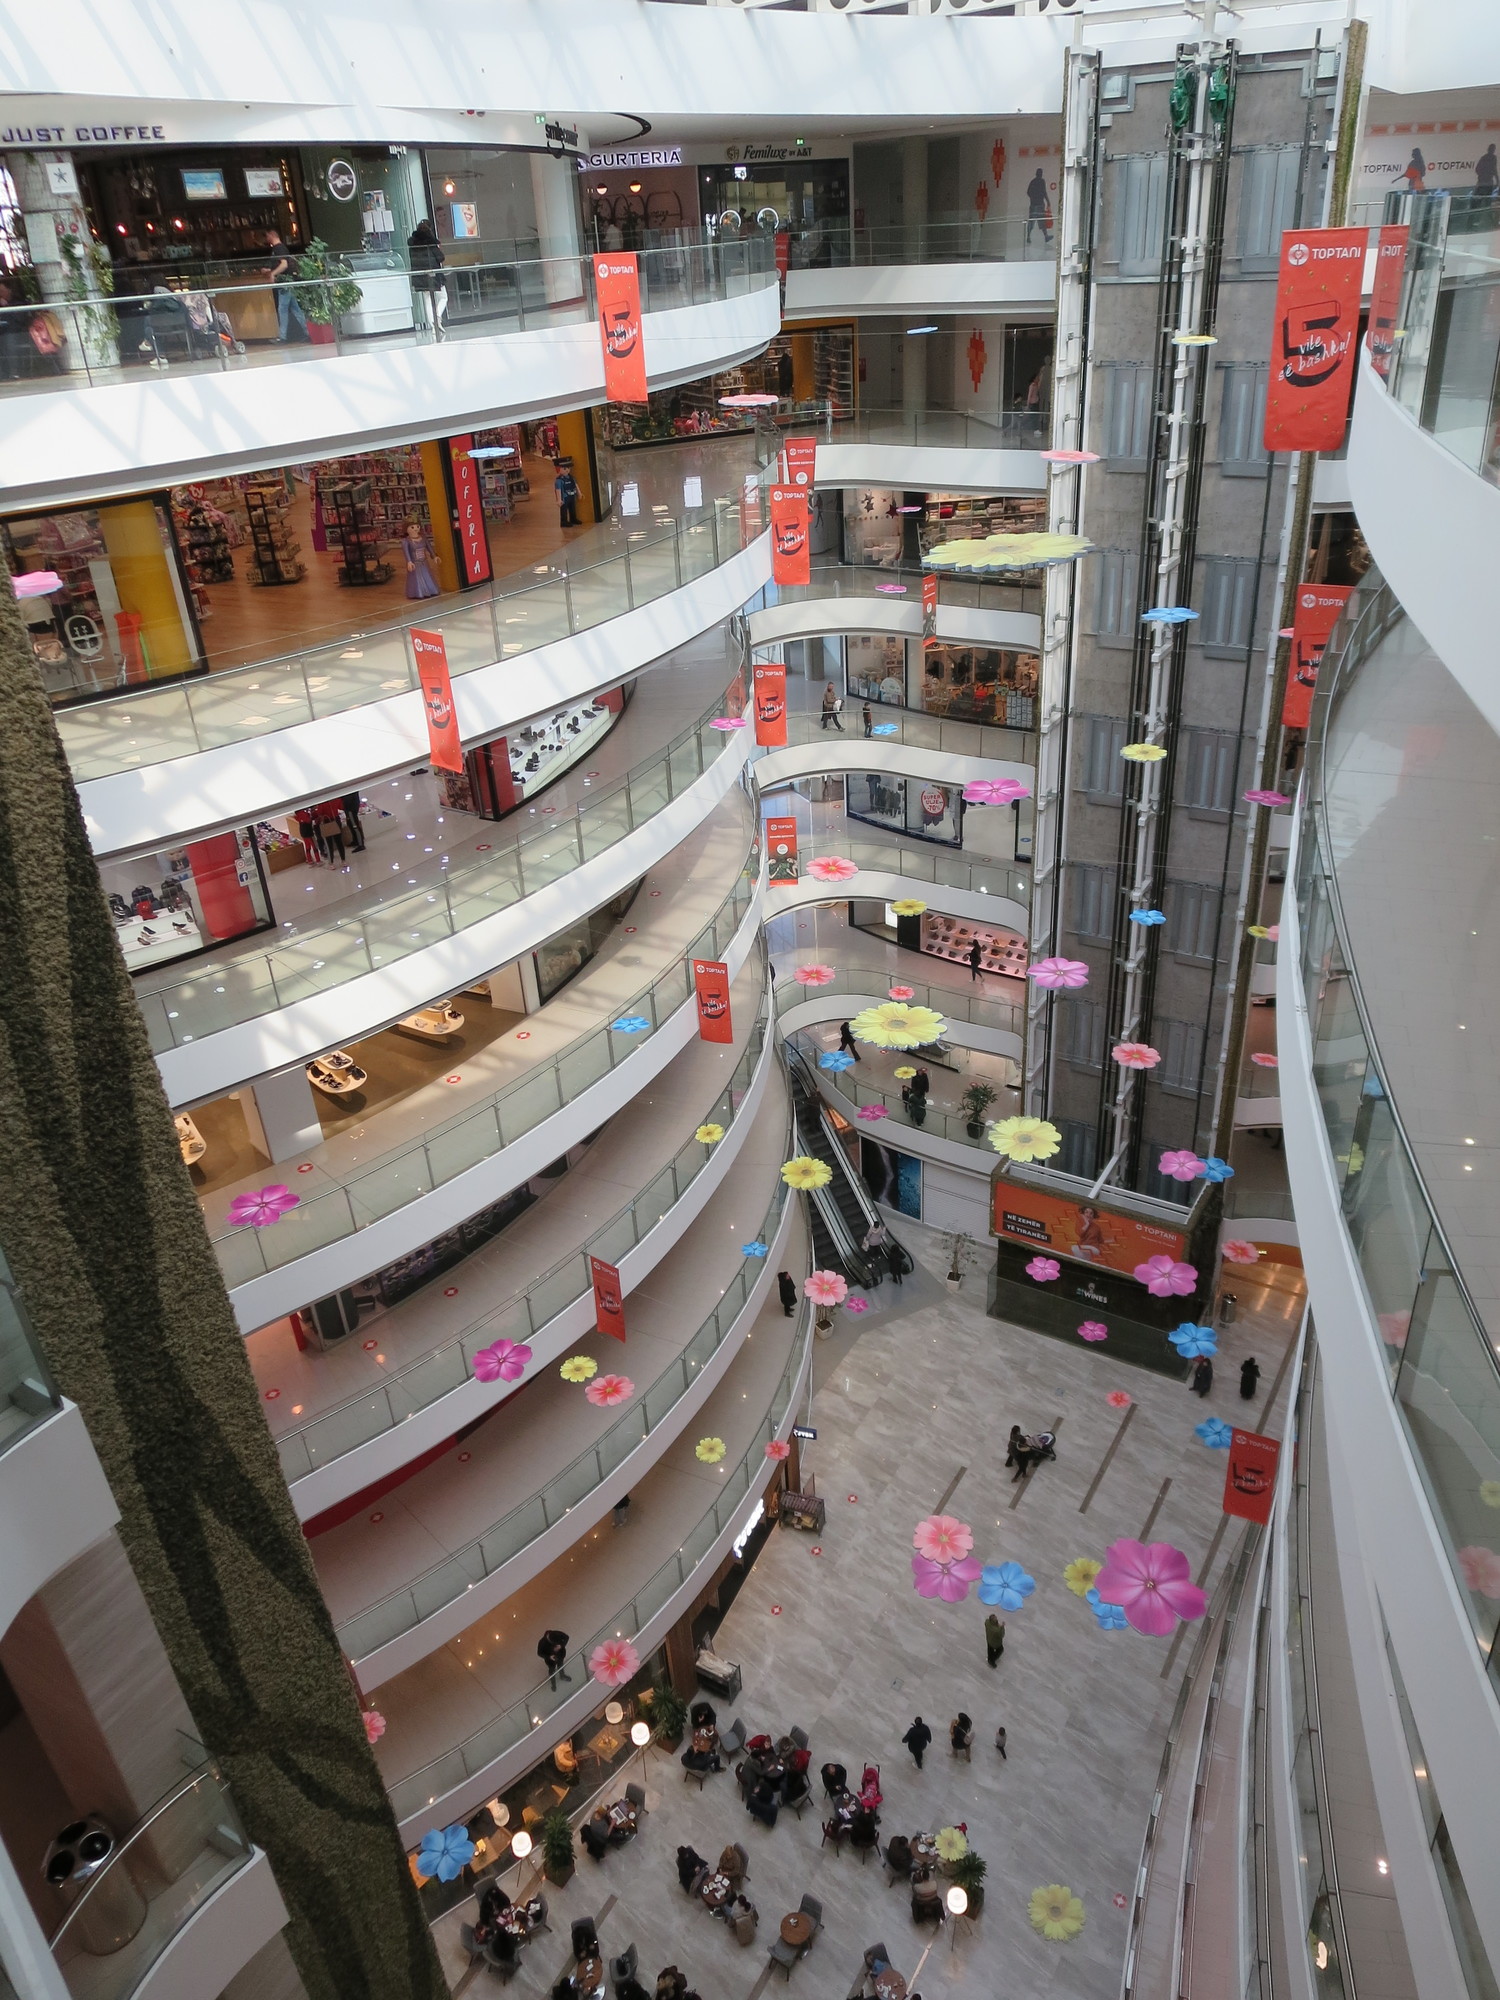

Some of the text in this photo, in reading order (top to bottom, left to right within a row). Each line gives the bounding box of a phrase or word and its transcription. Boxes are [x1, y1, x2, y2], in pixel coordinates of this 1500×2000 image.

[2, 125, 165, 143] JUST COFFEE
[743, 144, 787, 159] Femiluxe
[796, 147, 812, 157] A&T
[1363, 164, 1402, 173] TOPTANI
[1437, 161, 1475, 171] TOPTANI
[1312, 247, 1361, 259] TOPTANI
[610, 266, 634, 274] TOPTANI
[602, 301, 635, 358] 5
[1282, 300, 1344, 387] 5
[1299, 334, 1324, 353] vite
[1278, 363, 1294, 381] së
[1298, 332, 1352, 372] bashku!
[461, 466, 481, 574] OFERTA
[1318, 597, 1347, 606] TOPTA
[423, 642, 443, 654] TOPTANI
[1018, 1216, 1041, 1229] ZEMËR
[1144, 1226, 1177, 1241] TOPTANI
